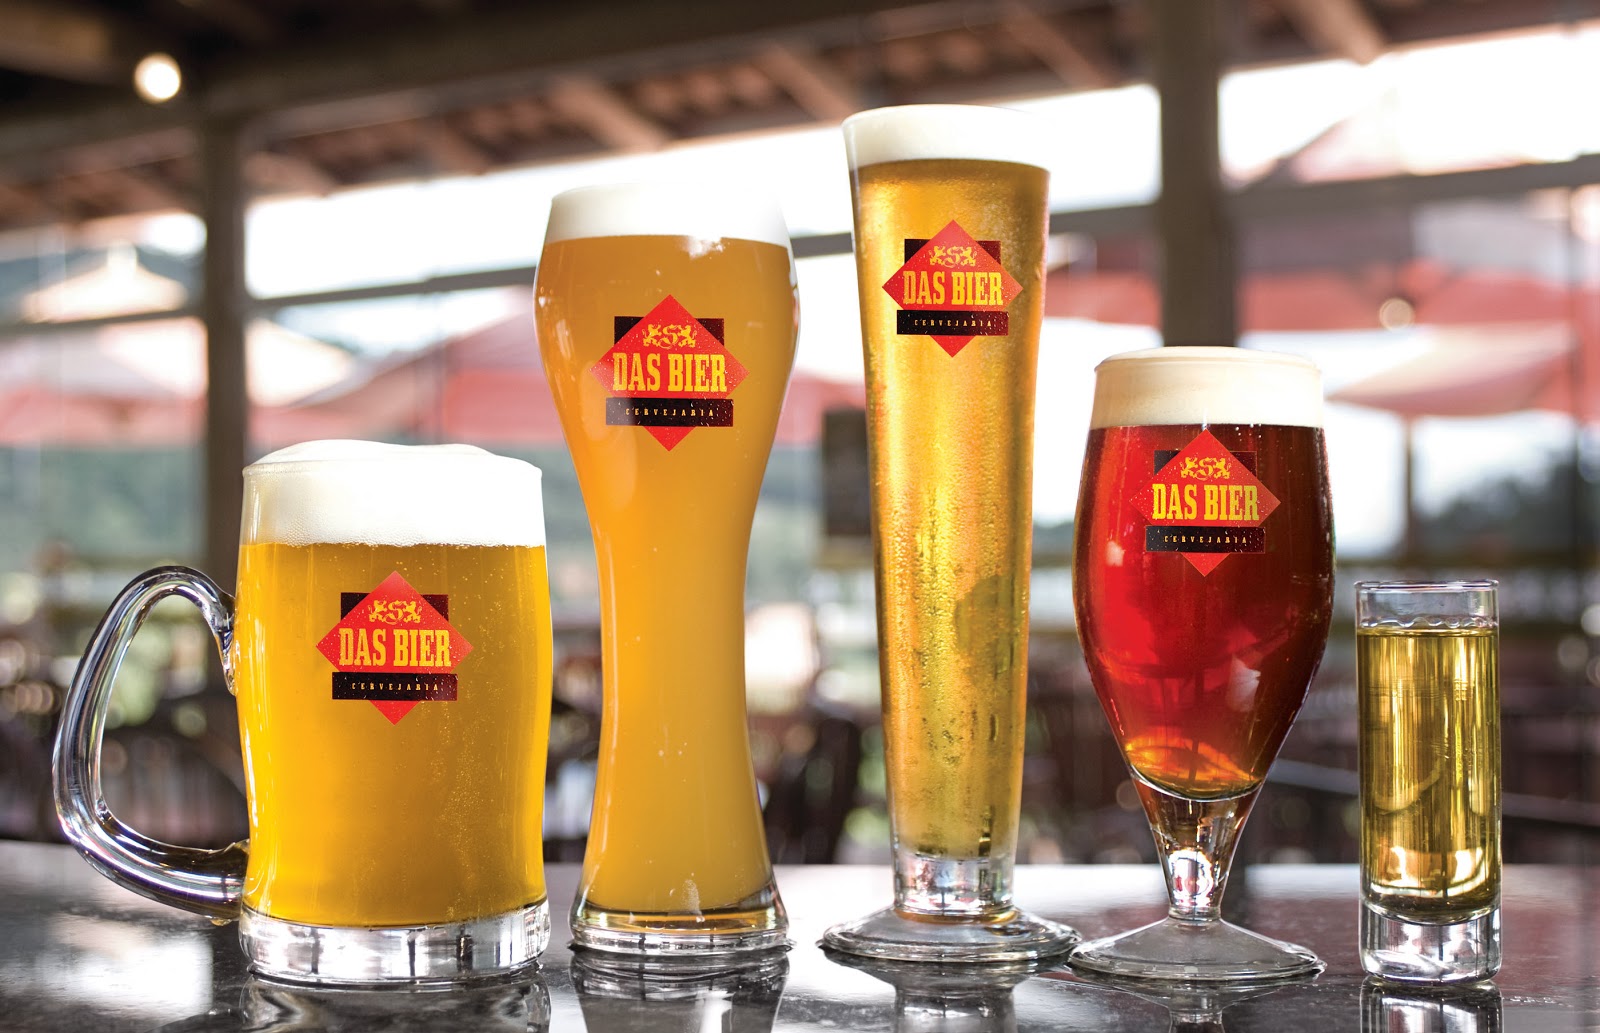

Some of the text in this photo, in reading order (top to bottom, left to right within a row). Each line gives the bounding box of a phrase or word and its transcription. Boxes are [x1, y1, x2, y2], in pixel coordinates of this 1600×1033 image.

[902, 270, 1004, 306] DAS BIER
[914, 319, 992, 327] CERVEJARIA
[612, 352, 727, 393] DAS BIER
[625, 408, 714, 417] CERVEJARIA
[1151, 483, 1260, 521] DAS BIER
[1164, 535, 1247, 544] CERVEJARIA
[338, 627, 452, 667] DAS BIER
[351, 682, 439, 691] CERVEJARIA
